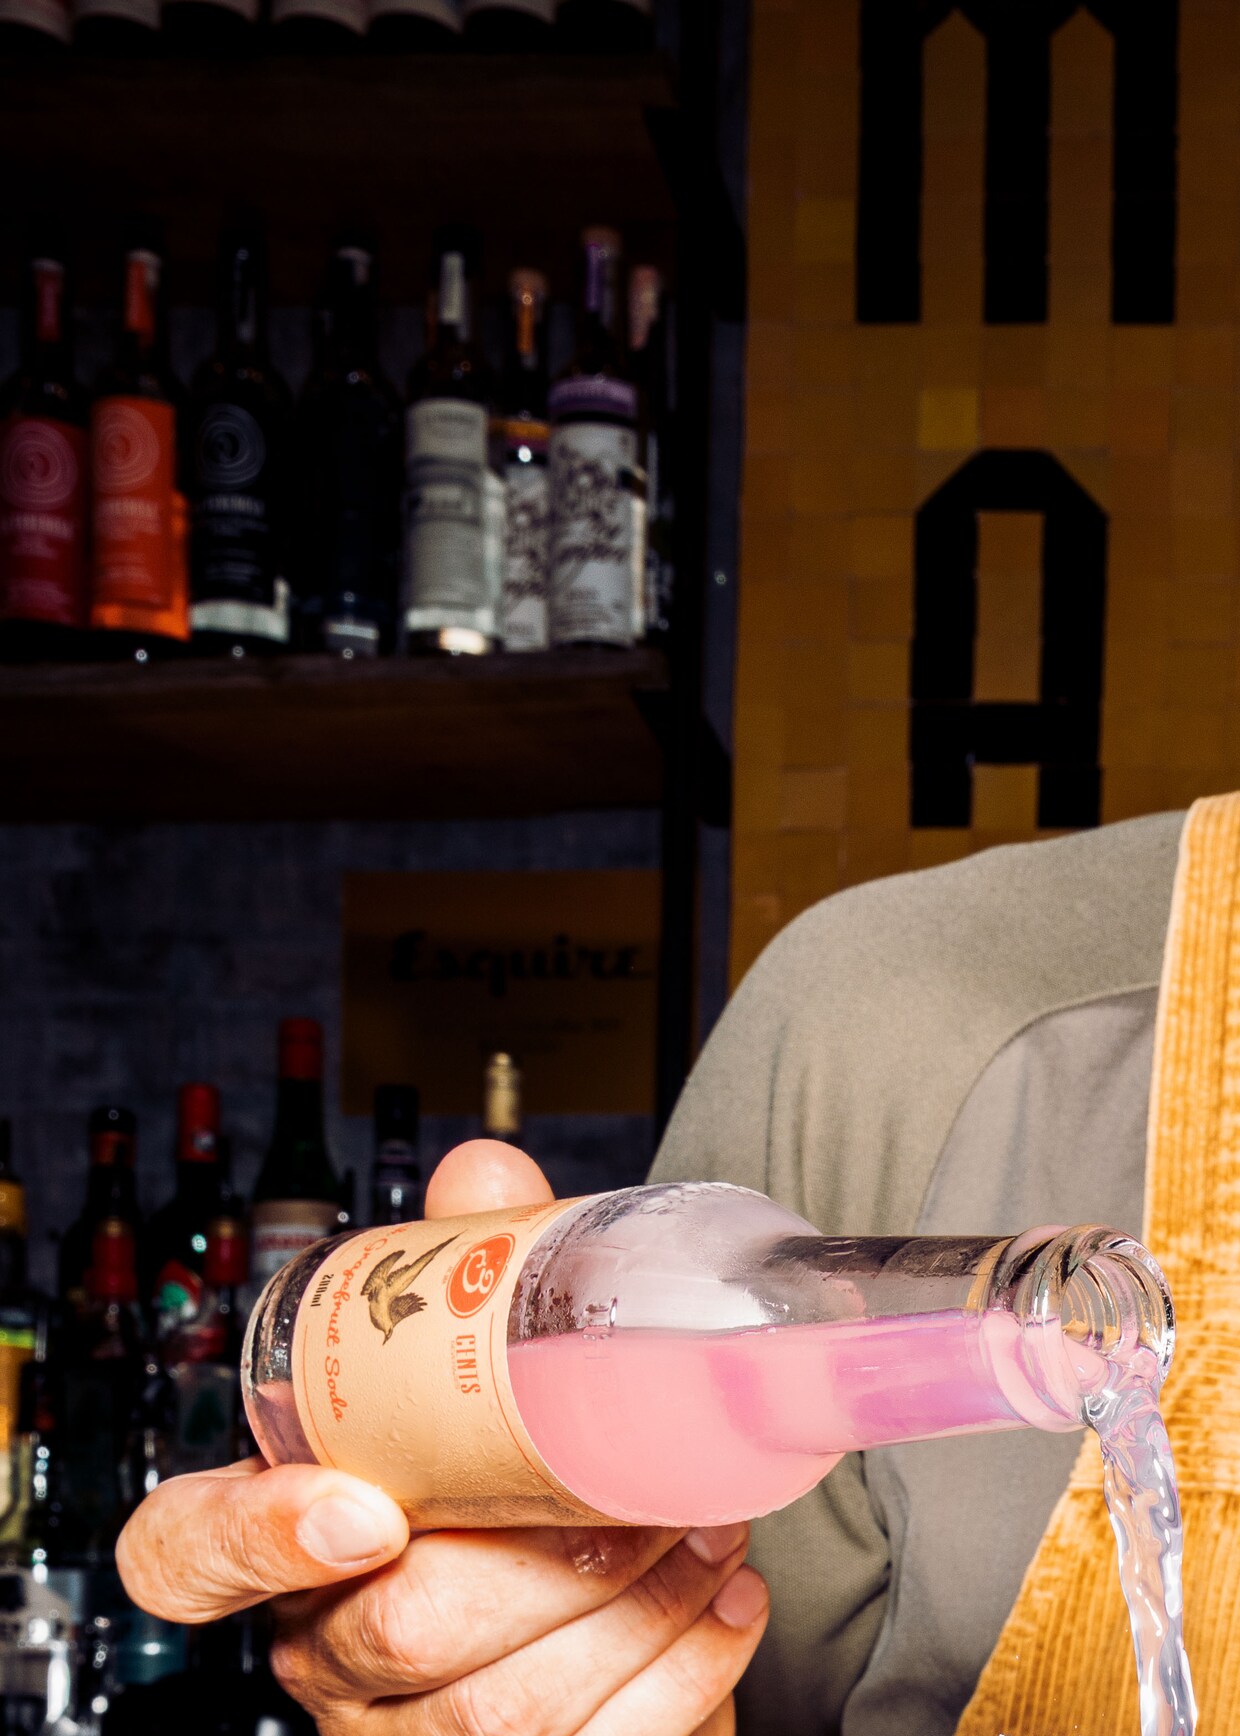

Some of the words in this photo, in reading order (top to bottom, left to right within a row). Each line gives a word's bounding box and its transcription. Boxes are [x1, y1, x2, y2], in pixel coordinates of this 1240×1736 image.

[388, 929, 653, 998] Esquire
[309, 1272, 335, 1308] 200ml
[325, 1237, 389, 1348] Grapefruit
[462, 1248, 495, 1295] 3
[324, 1355, 348, 1424] Soda
[455, 1333, 482, 1395] CENTS
